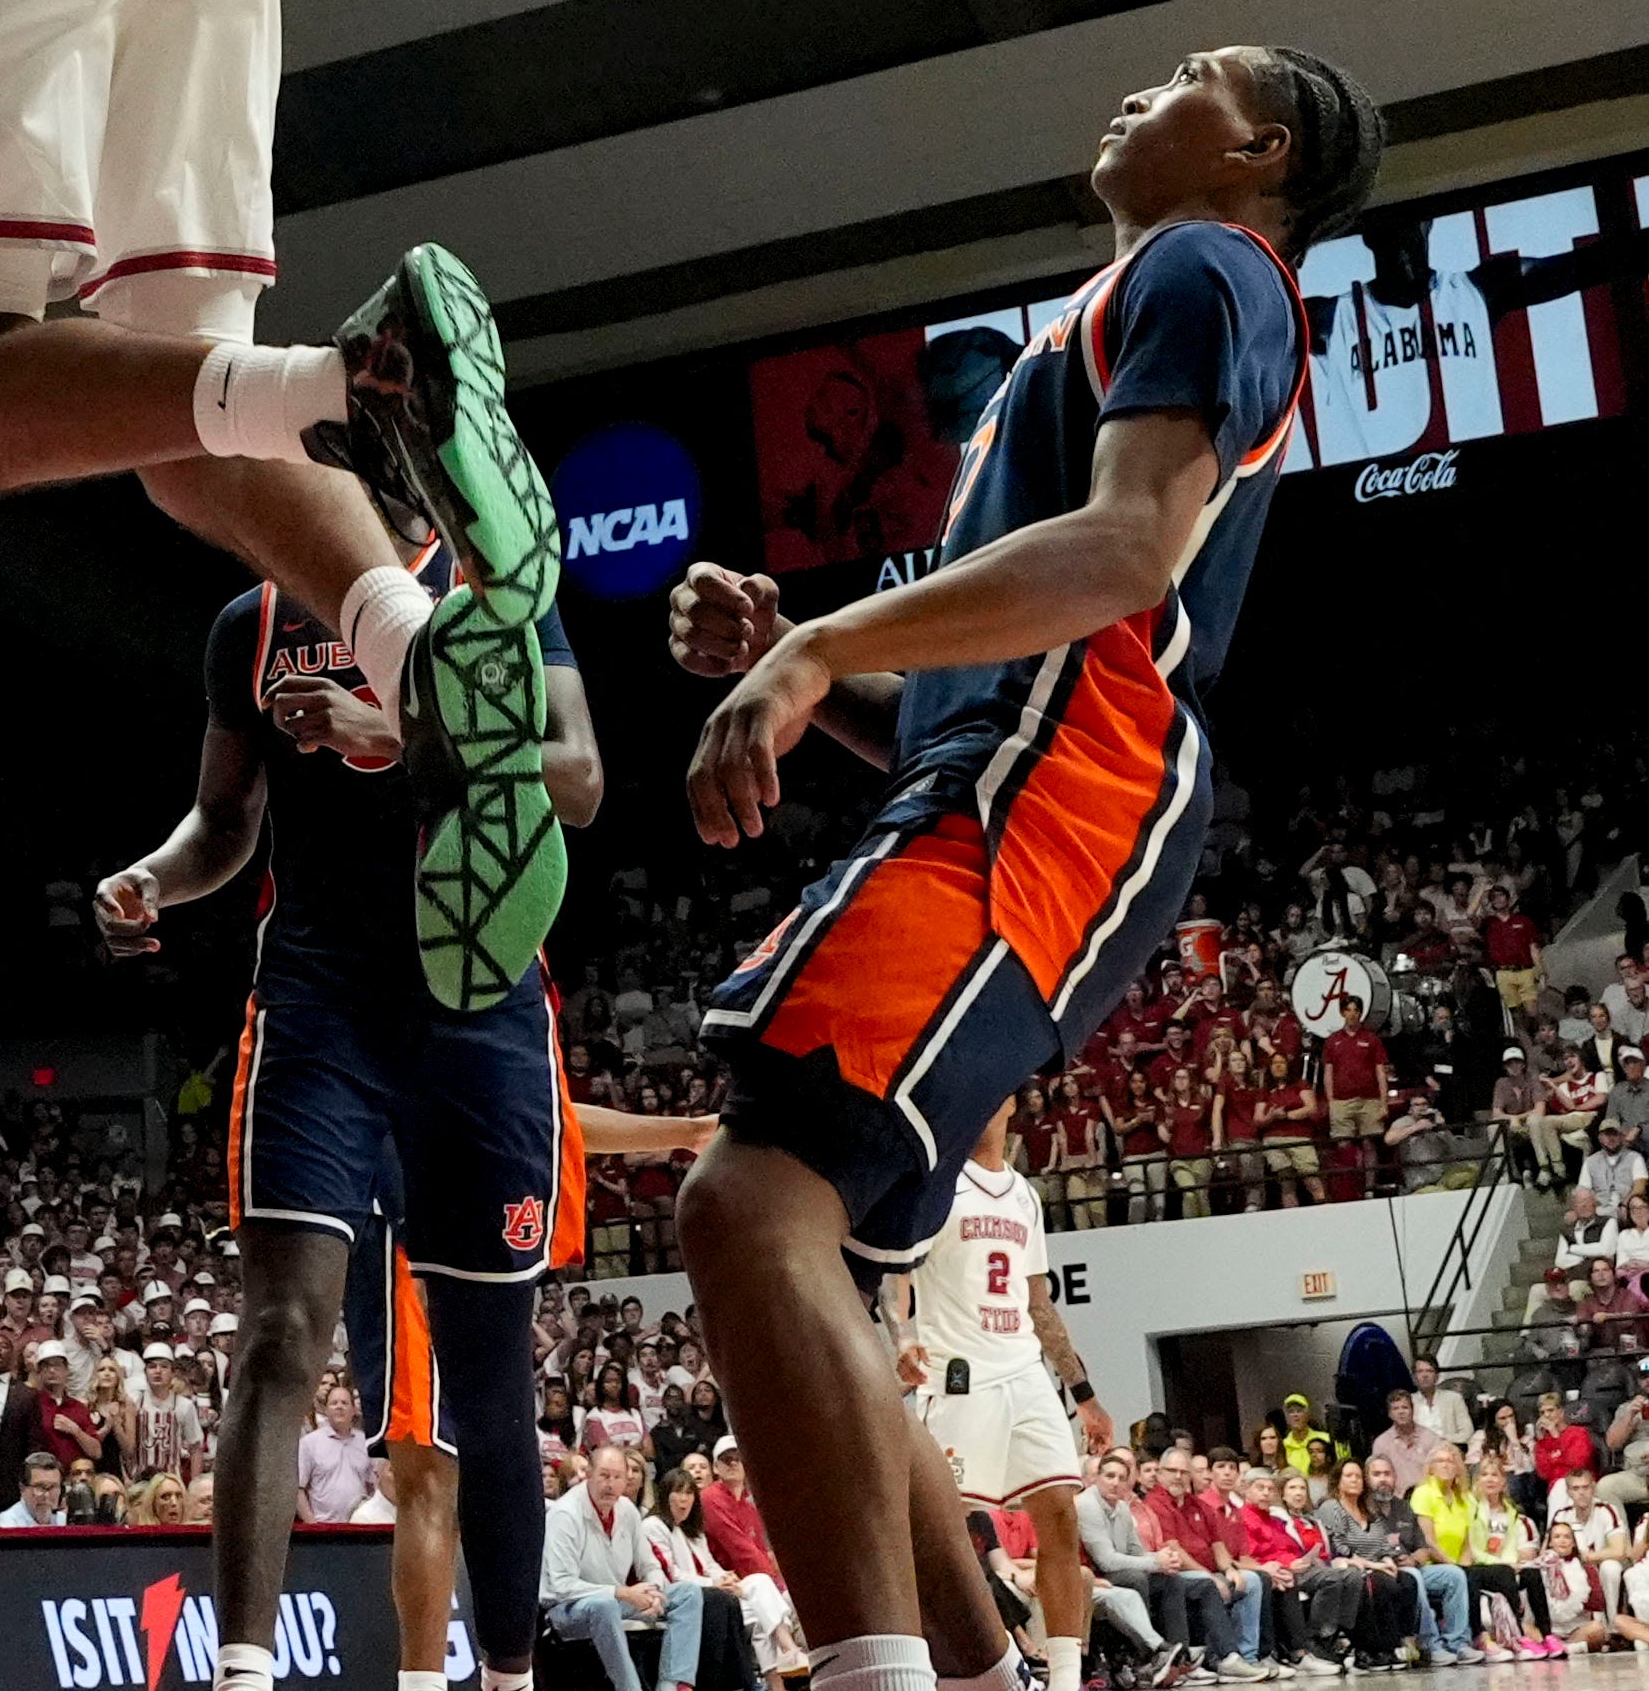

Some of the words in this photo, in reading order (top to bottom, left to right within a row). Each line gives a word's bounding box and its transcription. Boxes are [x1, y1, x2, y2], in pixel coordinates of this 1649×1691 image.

[1354, 449, 1461, 503] Coca-Cola
[566, 498, 689, 561] NCAA
[960, 1214, 1028, 1249] CRIMSON
[987, 1250, 1010, 1296] 2
[1304, 1272, 1328, 1294] EXIT
[978, 1305, 1021, 1334] TIDE
